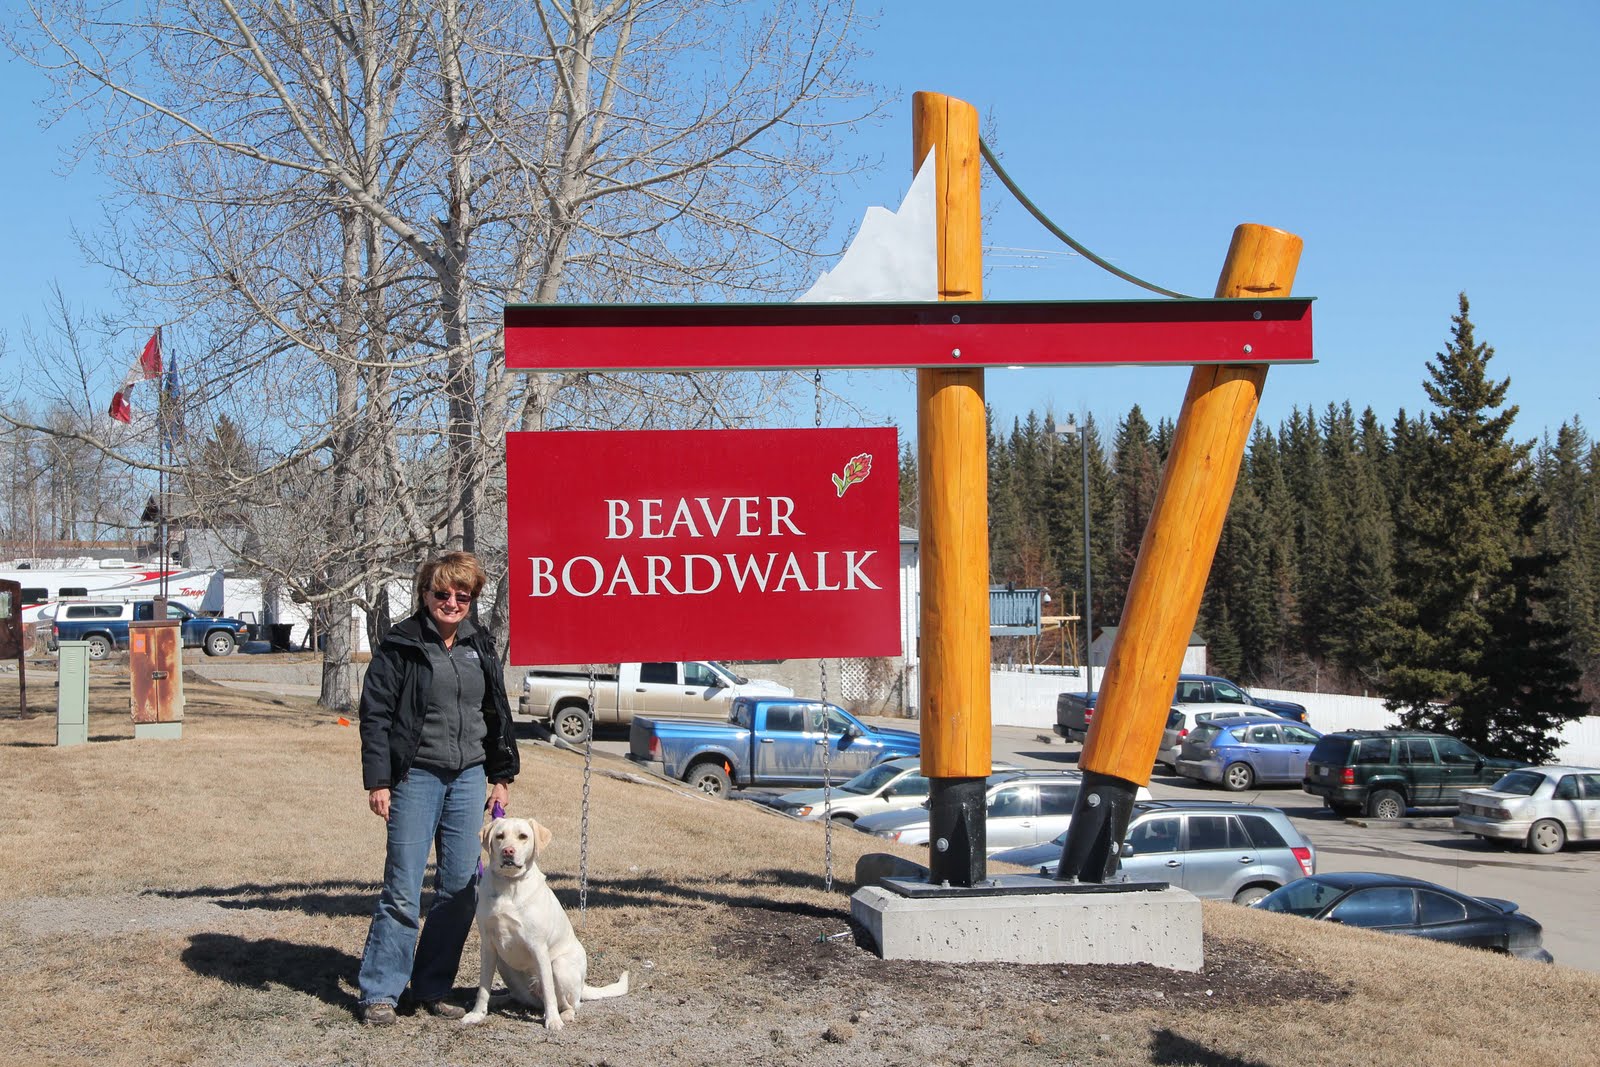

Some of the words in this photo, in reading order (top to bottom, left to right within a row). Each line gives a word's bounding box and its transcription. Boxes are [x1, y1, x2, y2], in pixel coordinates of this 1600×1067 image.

[604, 496, 806, 539] BEAVER
[179, 587, 206, 599] Tango
[528, 550, 882, 597] BOARDWALK
